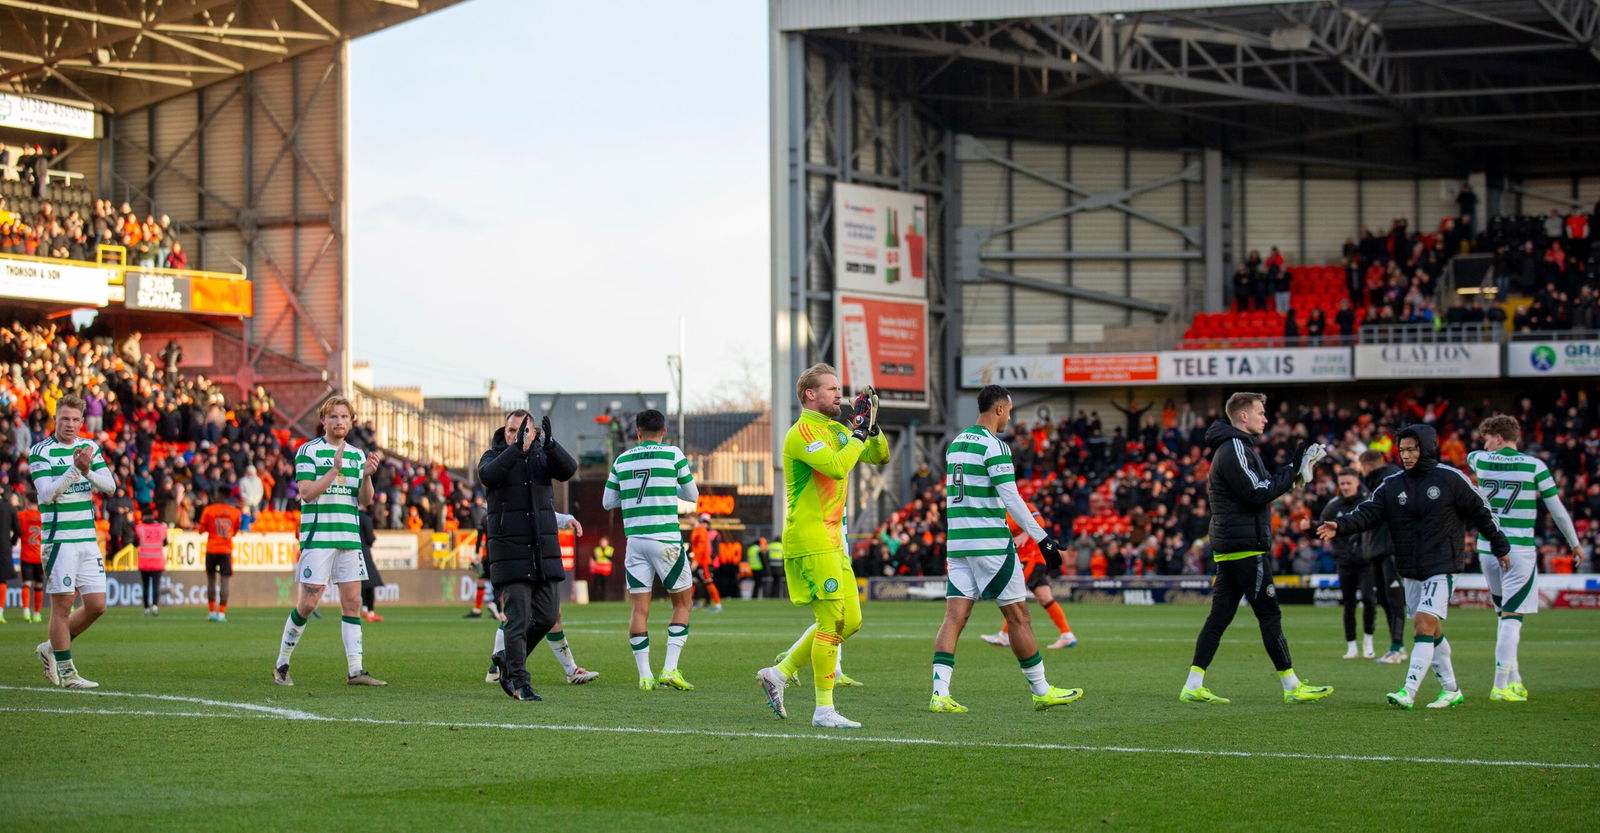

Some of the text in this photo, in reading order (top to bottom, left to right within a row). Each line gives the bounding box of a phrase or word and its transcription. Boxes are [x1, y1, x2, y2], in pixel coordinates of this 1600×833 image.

[1381, 344, 1470, 361] CLAYTON
[1173, 358, 1217, 376] TELE
[1226, 356, 1294, 375] TAXIS
[633, 468, 651, 504] 7
[952, 464, 964, 504] 9
[1483, 479, 1522, 514] 27
[29, 526, 41, 545] 2
[215, 517, 232, 538] 12
[97, 558, 104, 573] 5
[1424, 581, 1438, 597] 41
